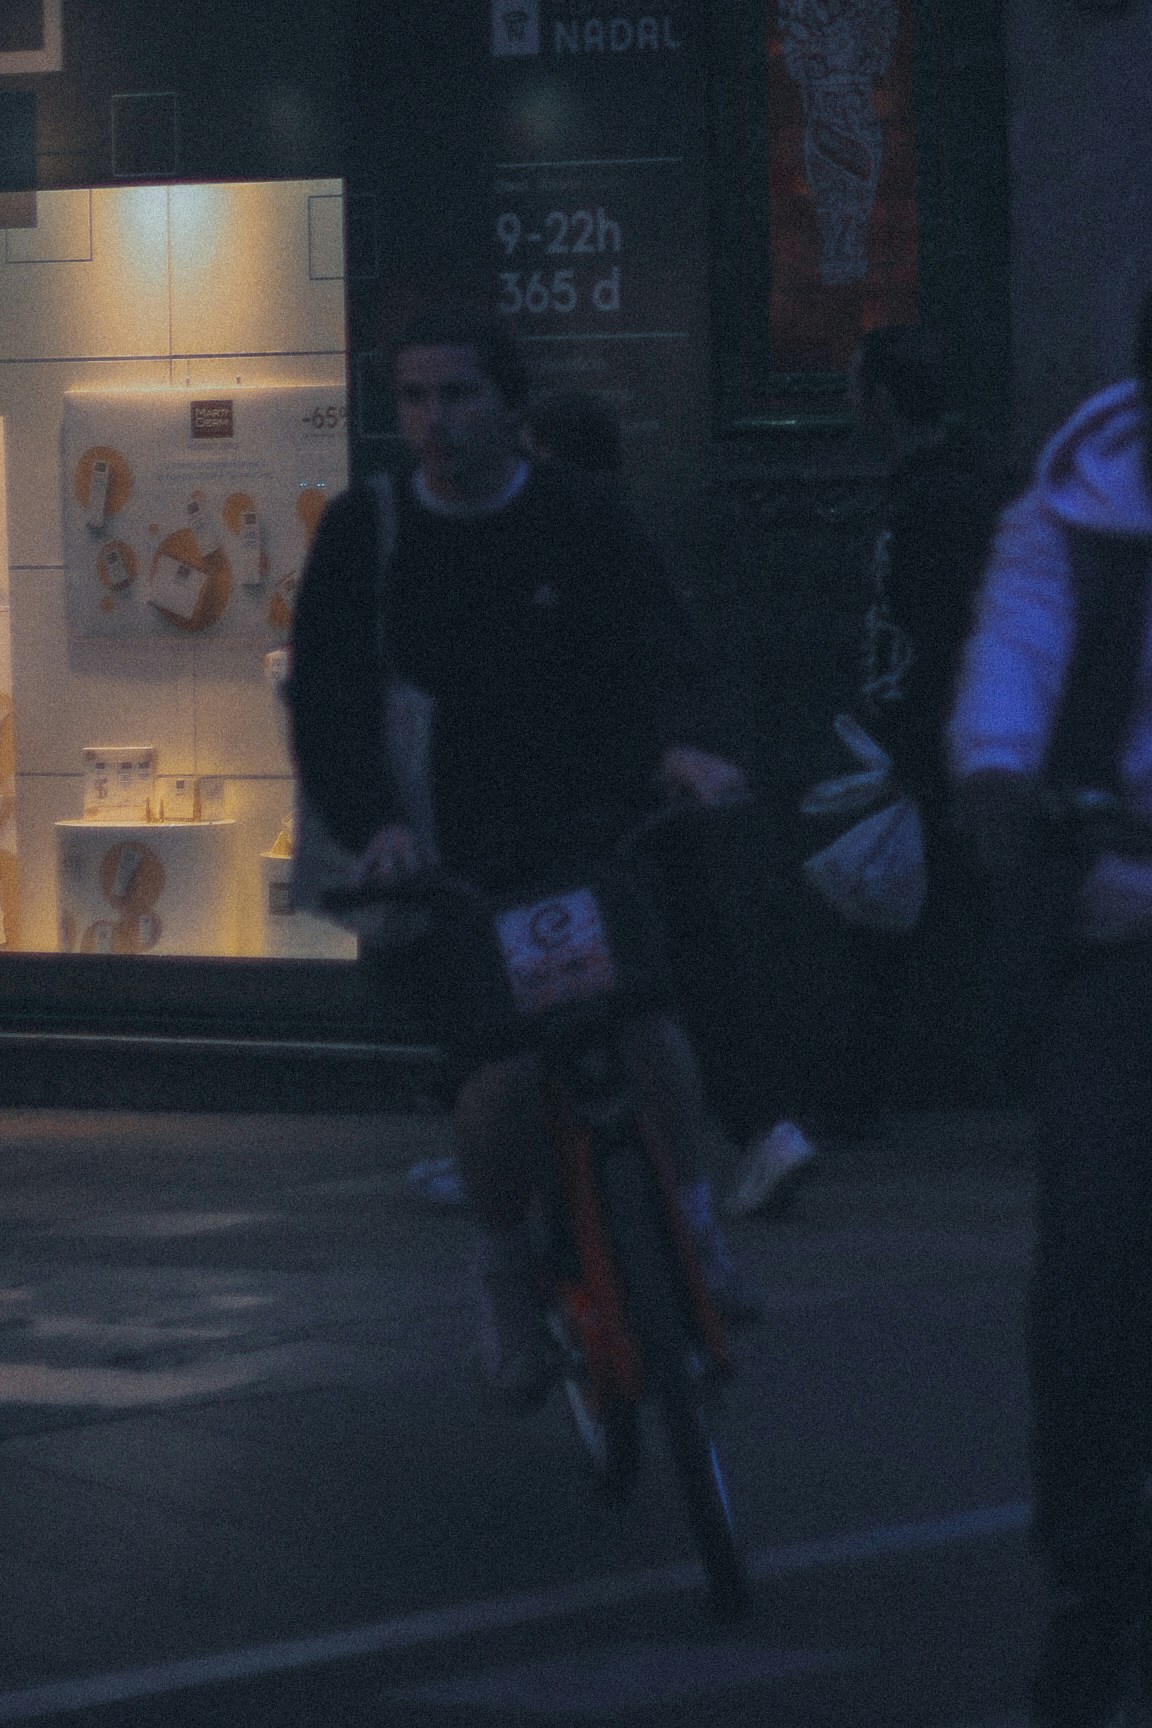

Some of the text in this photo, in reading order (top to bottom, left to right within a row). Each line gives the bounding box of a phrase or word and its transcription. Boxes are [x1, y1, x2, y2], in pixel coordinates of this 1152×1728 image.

[554, 17, 681, 54] NADAL
[496, 208, 622, 254] 9-22h
[498, 266, 621, 313] 365 d
